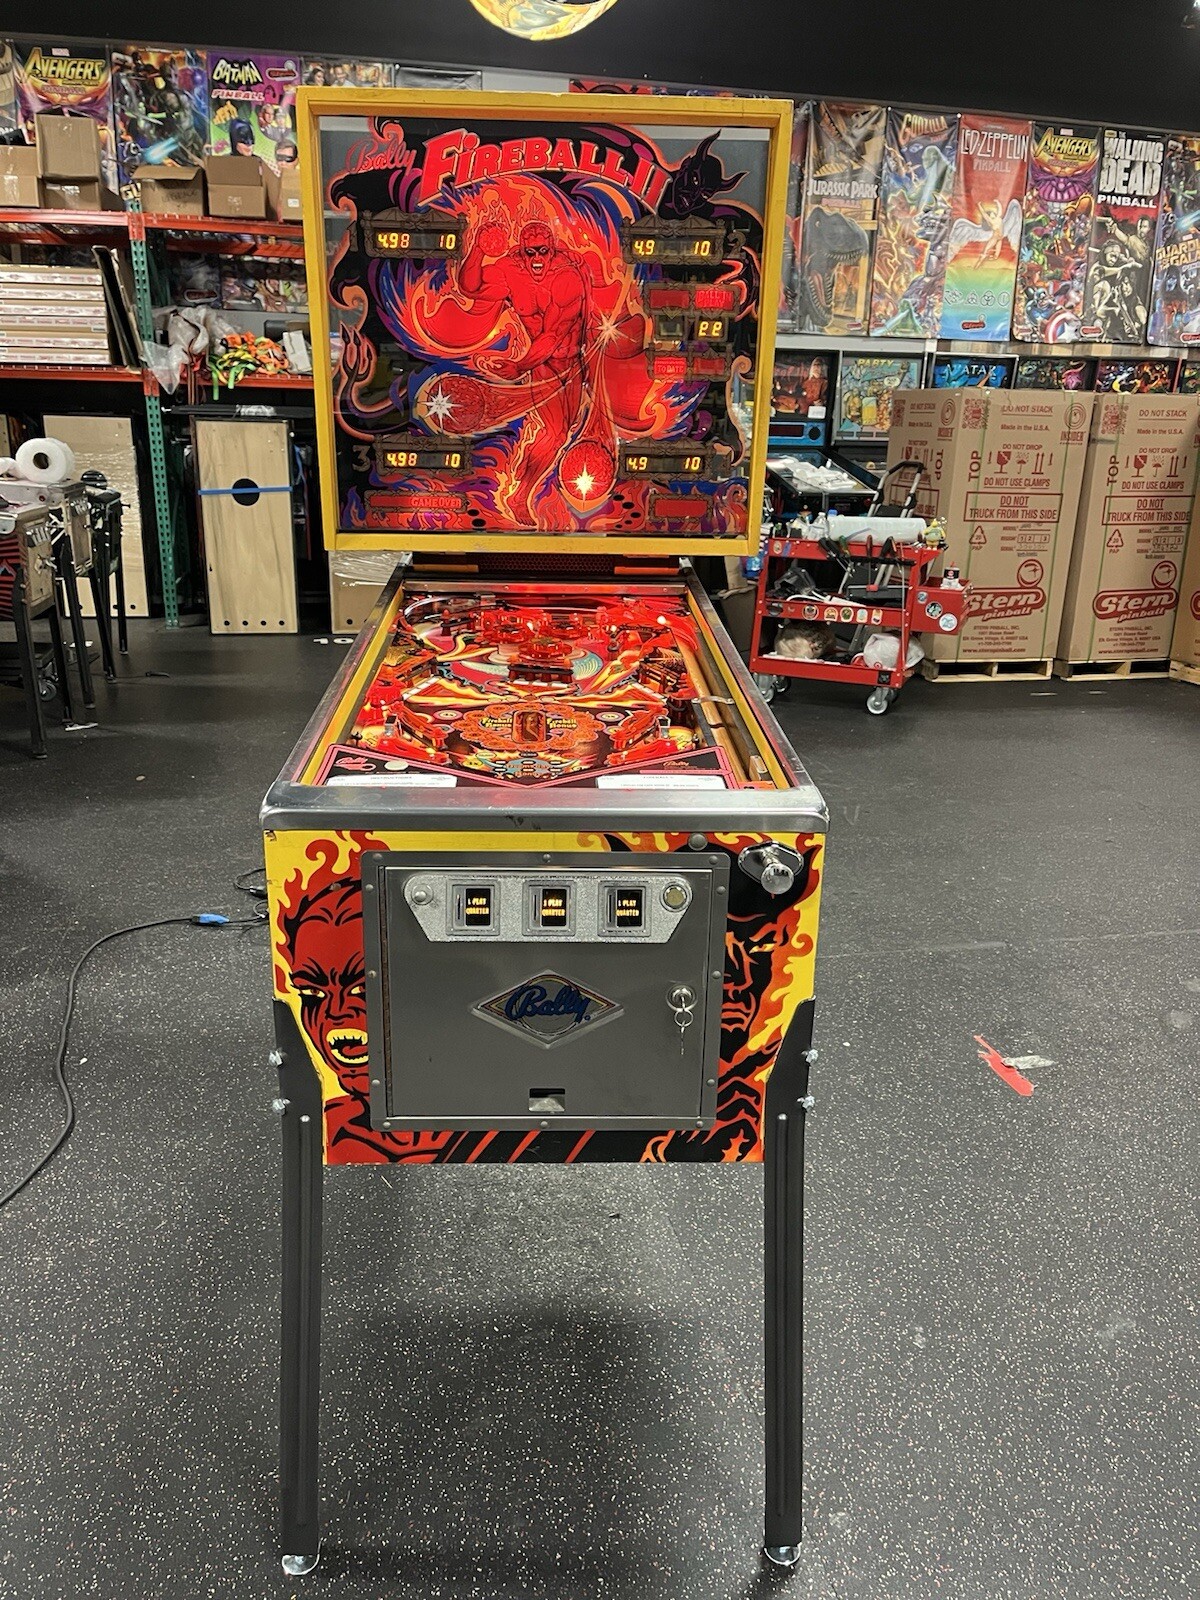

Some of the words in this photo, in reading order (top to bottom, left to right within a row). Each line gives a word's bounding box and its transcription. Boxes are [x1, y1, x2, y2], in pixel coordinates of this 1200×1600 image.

[25, 46, 105, 80] AVENGERS
[212, 58, 263, 85] BATMAN
[211, 88, 265, 101] PINBALL
[901, 113, 949, 145] GODZILLA
[1035, 127, 1096, 157] AVENGERS
[345, 137, 418, 175] Bally
[1103, 137, 1164, 163] WALKING
[417, 128, 634, 208] FIREBALL
[1099, 158, 1164, 197] DEAD
[807, 179, 850, 197] JURASSIC
[850, 180, 879, 199] PARK
[1097, 194, 1158, 209] PINBALL
[1031, 405, 1054, 413] STACK
[1139, 409, 1149, 417] DO
[1151, 409, 1165, 417] NOT
[1166, 409, 1188, 417] STACK
[934, 448, 944, 480] TOP
[968, 450, 981, 482] TOP
[1106, 455, 1120, 486] TOP
[983, 477, 993, 486] DO
[995, 477, 1008, 486] NOT
[1009, 477, 1023, 486] USE
[1023, 478, 1051, 487] CLAMPS
[1121, 481, 1131, 490] DO
[1131, 481, 1145, 490] NOT
[1145, 481, 1158, 490] USE
[1159, 481, 1185, 490] CLAMPS
[410, 496, 438, 508] GAME
[439, 496, 461, 508] OVER
[1000, 495, 1012, 506] DO
[1013, 496, 1029, 506] NOT
[1136, 499, 1148, 509] DO
[1149, 498, 1165, 508] NOT
[969, 508, 996, 518] TRUCK
[996, 508, 1019, 519] FROM
[1020, 509, 1038, 519] THIS
[1039, 509, 1057, 520] SIDE
[1107, 512, 1132, 521] TRUCK
[1132, 512, 1155, 521] FROM
[1156, 511, 1172, 521] THIS
[1173, 511, 1191, 521] SIDE
[968, 593, 1037, 612] Stern
[1101, 593, 1170, 615] Stern
[982, 606, 1032, 621] pinball
[1118, 607, 1165, 623] pinball
[472, 897, 487, 906] PLAY
[547, 898, 563, 907] PLAY
[622, 899, 637, 907] PLAY
[465, 907, 490, 915] QUARTER
[541, 908, 566, 917] QUARTER
[615, 908, 640, 917] QUARTER
[505, 984, 592, 1024] Bally
